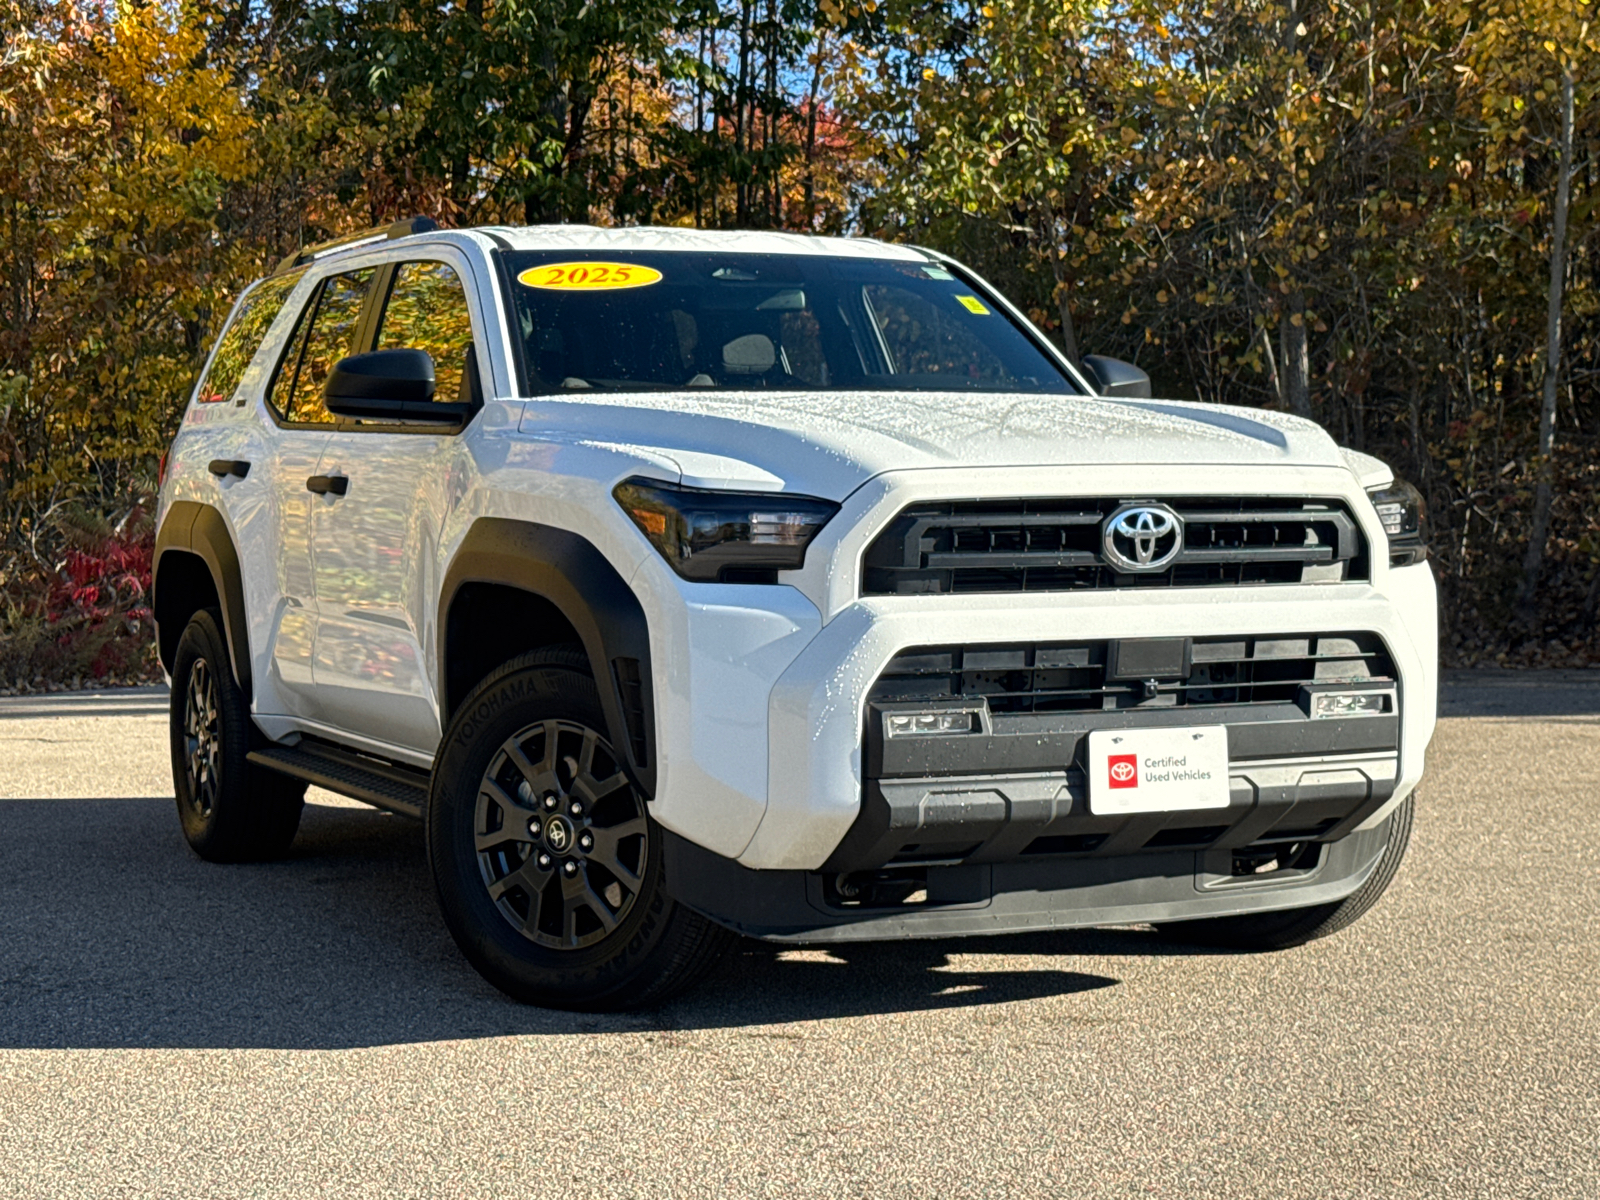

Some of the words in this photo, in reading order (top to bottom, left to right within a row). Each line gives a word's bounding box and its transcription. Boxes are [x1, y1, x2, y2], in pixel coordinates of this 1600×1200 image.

[544, 267, 633, 285] 2025
[454, 677, 537, 748] YOKOHAMA
[1144, 756, 1187, 768] Certified
[1145, 771, 1170, 782] Used
[1172, 769, 1212, 781] Vehicles
